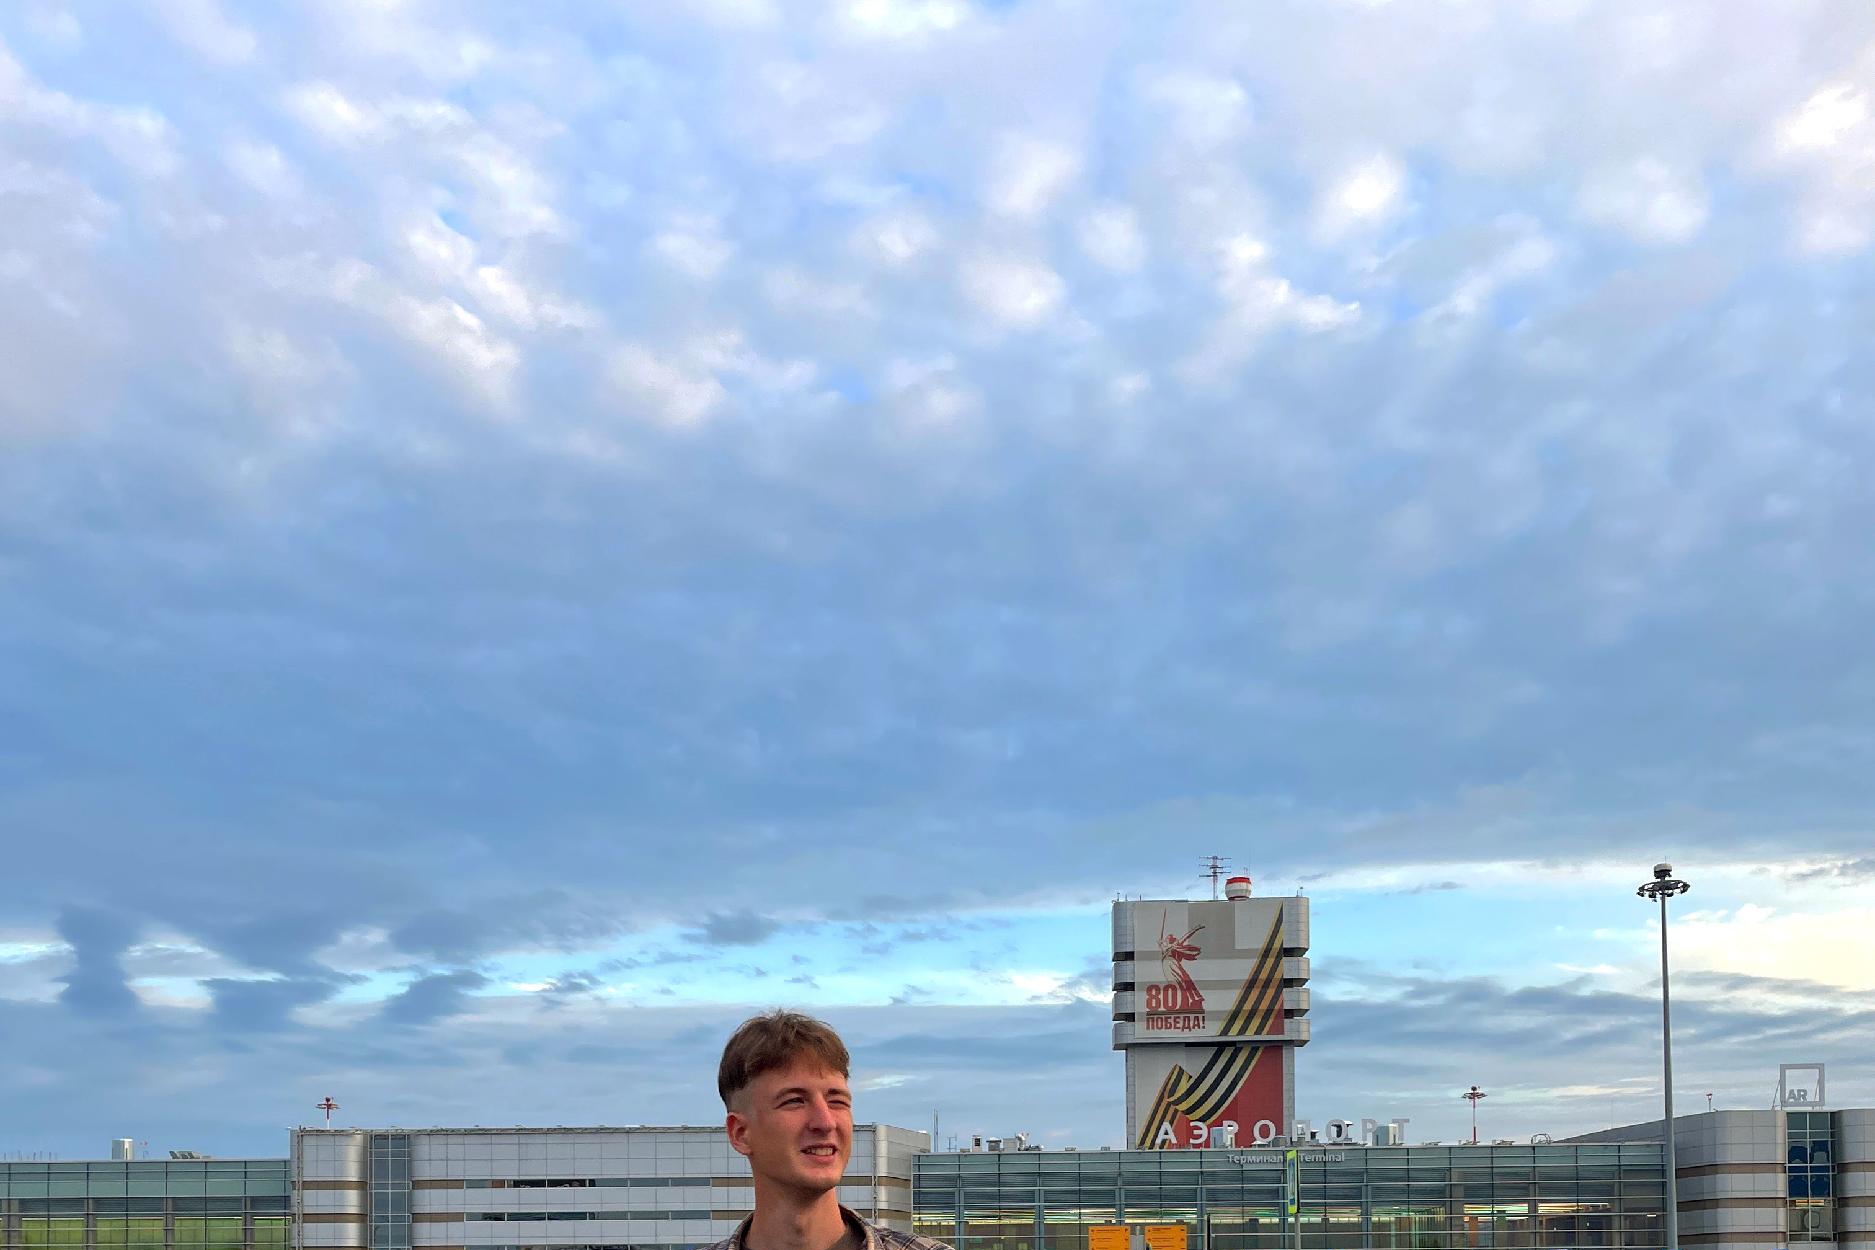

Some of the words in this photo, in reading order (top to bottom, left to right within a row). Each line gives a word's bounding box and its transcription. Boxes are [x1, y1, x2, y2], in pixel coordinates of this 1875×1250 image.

[1146, 983, 1178, 1011] 80
[1146, 1016, 1206, 1032] ПОБЕДА!
[1155, 1118, 1410, 1145] АЭРОПОРТ
[1227, 1154, 1284, 1164] Терминал
[1298, 1152, 1345, 1162] Terminal
